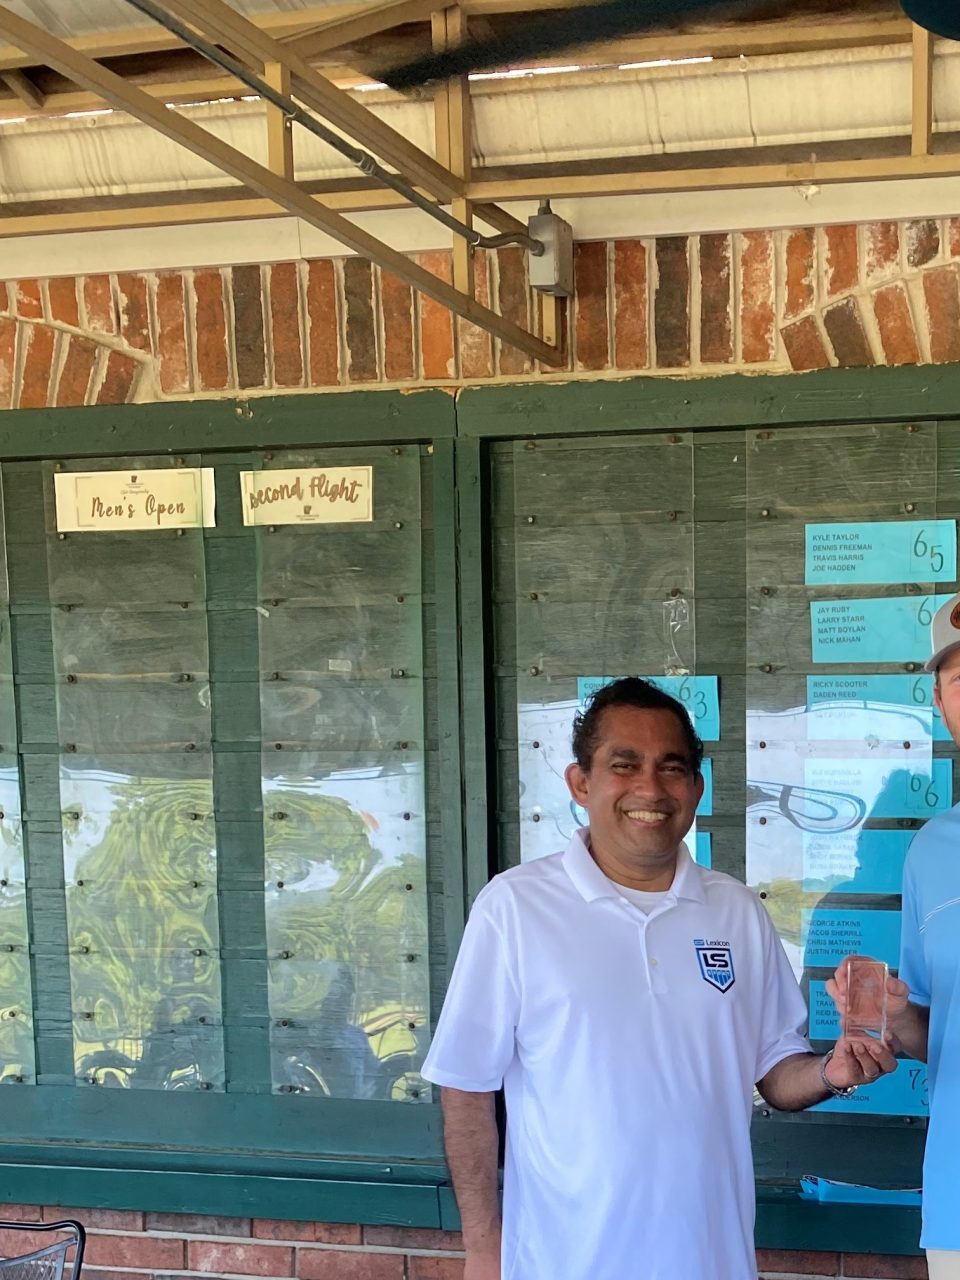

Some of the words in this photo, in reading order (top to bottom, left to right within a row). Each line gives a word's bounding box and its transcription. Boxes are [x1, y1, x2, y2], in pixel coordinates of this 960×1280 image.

[91, 496, 136, 518] Men's
[145, 494, 186, 525] Open
[832, 533, 860, 541] TAYLOR
[839, 543, 872, 551] FREEMAN
[913, 529, 944, 573] 65
[812, 564, 825, 572] JOE
[918, 597, 932, 626] 6
[679, 677, 708, 719] 63
[912, 677, 926, 703] 6
[706, 939, 730, 947] Lexicon
